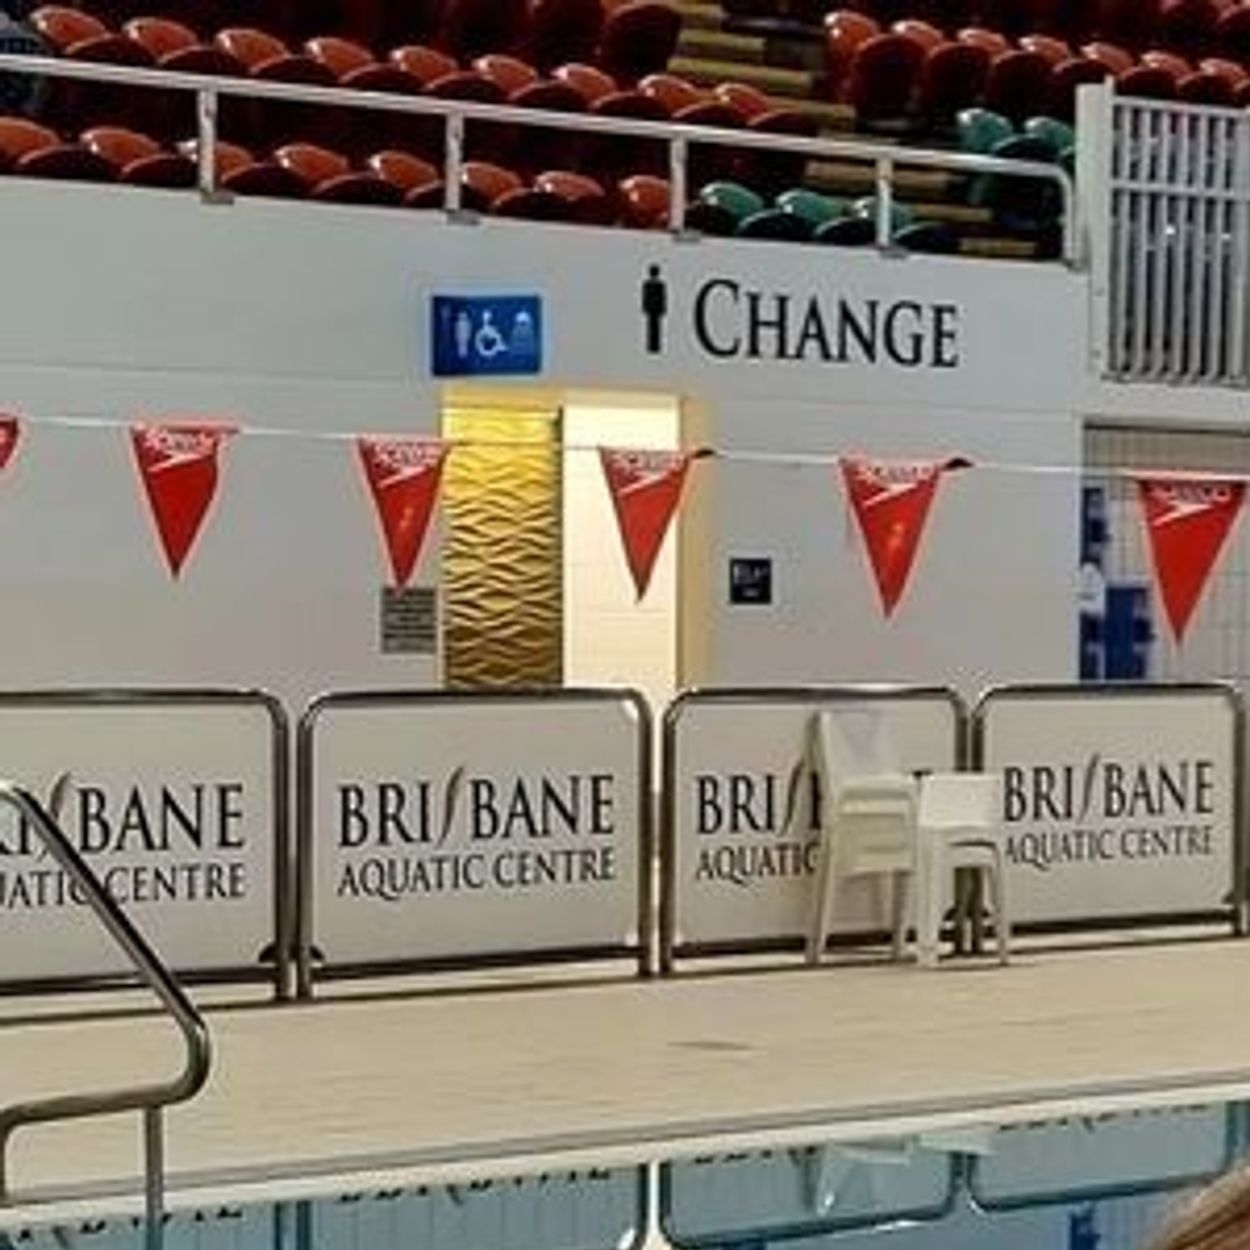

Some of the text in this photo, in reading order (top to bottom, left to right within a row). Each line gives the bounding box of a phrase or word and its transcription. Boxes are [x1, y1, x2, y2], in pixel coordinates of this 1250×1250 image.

[694, 277, 959, 368] CHANGE
[337, 766, 614, 848] BRISBANE
[1003, 753, 1214, 824] BRISBANE
[337, 847, 616, 901] AQUATIC CENTRE
[1004, 824, 1213, 871] AQUATIC CENTRE
[103, 862, 246, 904] CENTRE
